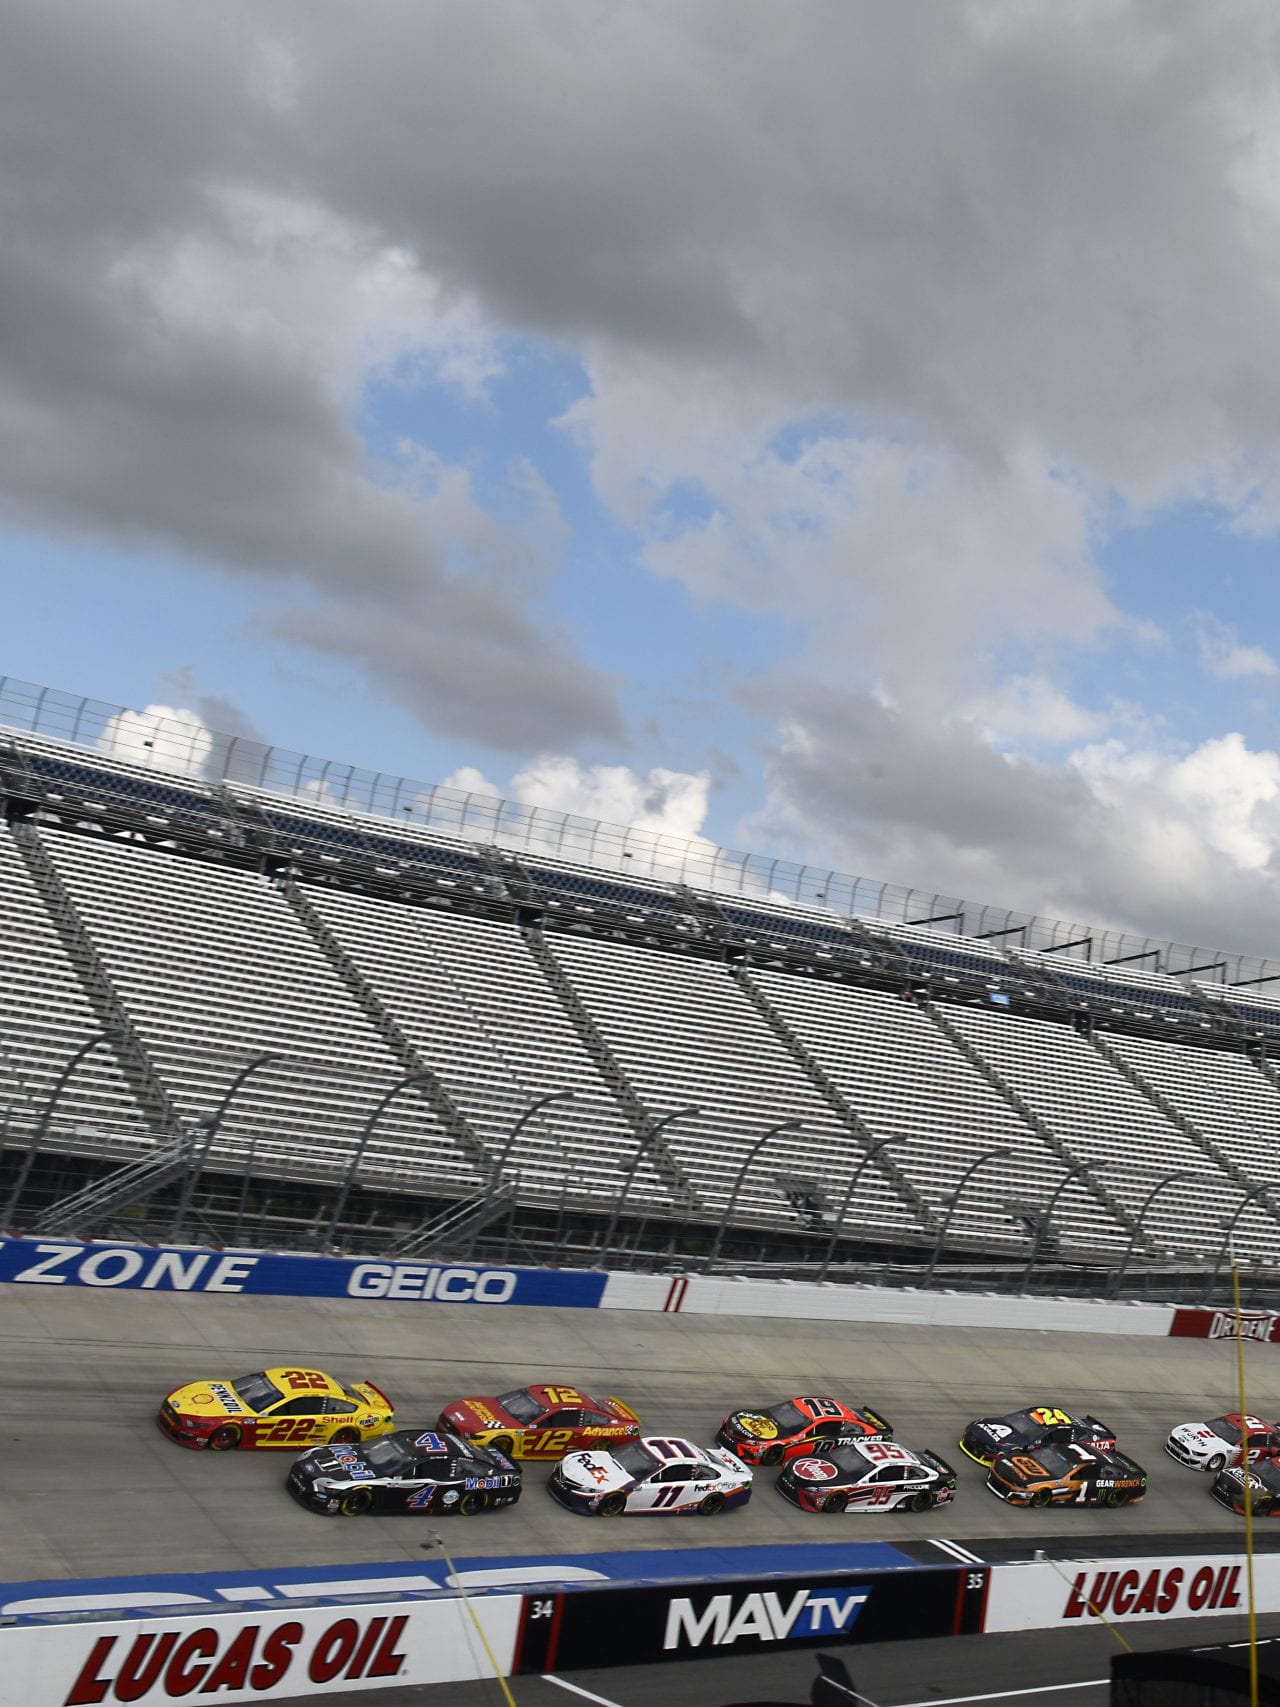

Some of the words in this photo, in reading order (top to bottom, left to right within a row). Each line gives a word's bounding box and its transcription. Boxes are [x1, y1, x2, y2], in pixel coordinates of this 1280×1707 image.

[13, 1244, 260, 1293] ZONE
[346, 1263, 517, 1303] GEICO
[283, 1370, 329, 1390] 22
[208, 1383, 245, 1414] PENNZOIL
[542, 1387, 583, 1404] 12
[801, 1398, 845, 1419] 19
[1033, 1407, 1072, 1426] 24
[265, 1418, 316, 1442] 22
[321, 1416, 354, 1424] Shell
[1244, 1415, 1265, 1430] 2
[533, 1430, 573, 1451] 12
[582, 1426, 625, 1437] Advance
[836, 1435, 883, 1446] TRACKER
[414, 1432, 448, 1453] 4
[647, 1439, 698, 1459] 11
[864, 1443, 905, 1461] 95
[1068, 1443, 1097, 1460] 1
[328, 1446, 376, 1480] Mobil
[572, 1452, 610, 1484] FedEx
[465, 1477, 500, 1490] Mobil
[694, 1483, 717, 1492] FedEx
[1075, 1482, 1089, 1502] 1
[405, 1484, 438, 1509] 4
[650, 1485, 685, 1508] 11
[867, 1486, 897, 1506] 95
[966, 1573, 984, 1590] 35
[1062, 1566, 1184, 1619] LUCAS
[1187, 1565, 1242, 1612] OIL
[530, 1600, 554, 1619] 34
[663, 1586, 868, 1650] MAVTV
[64, 1621, 304, 1706] LUCAS
[307, 1615, 411, 1684] OIL
